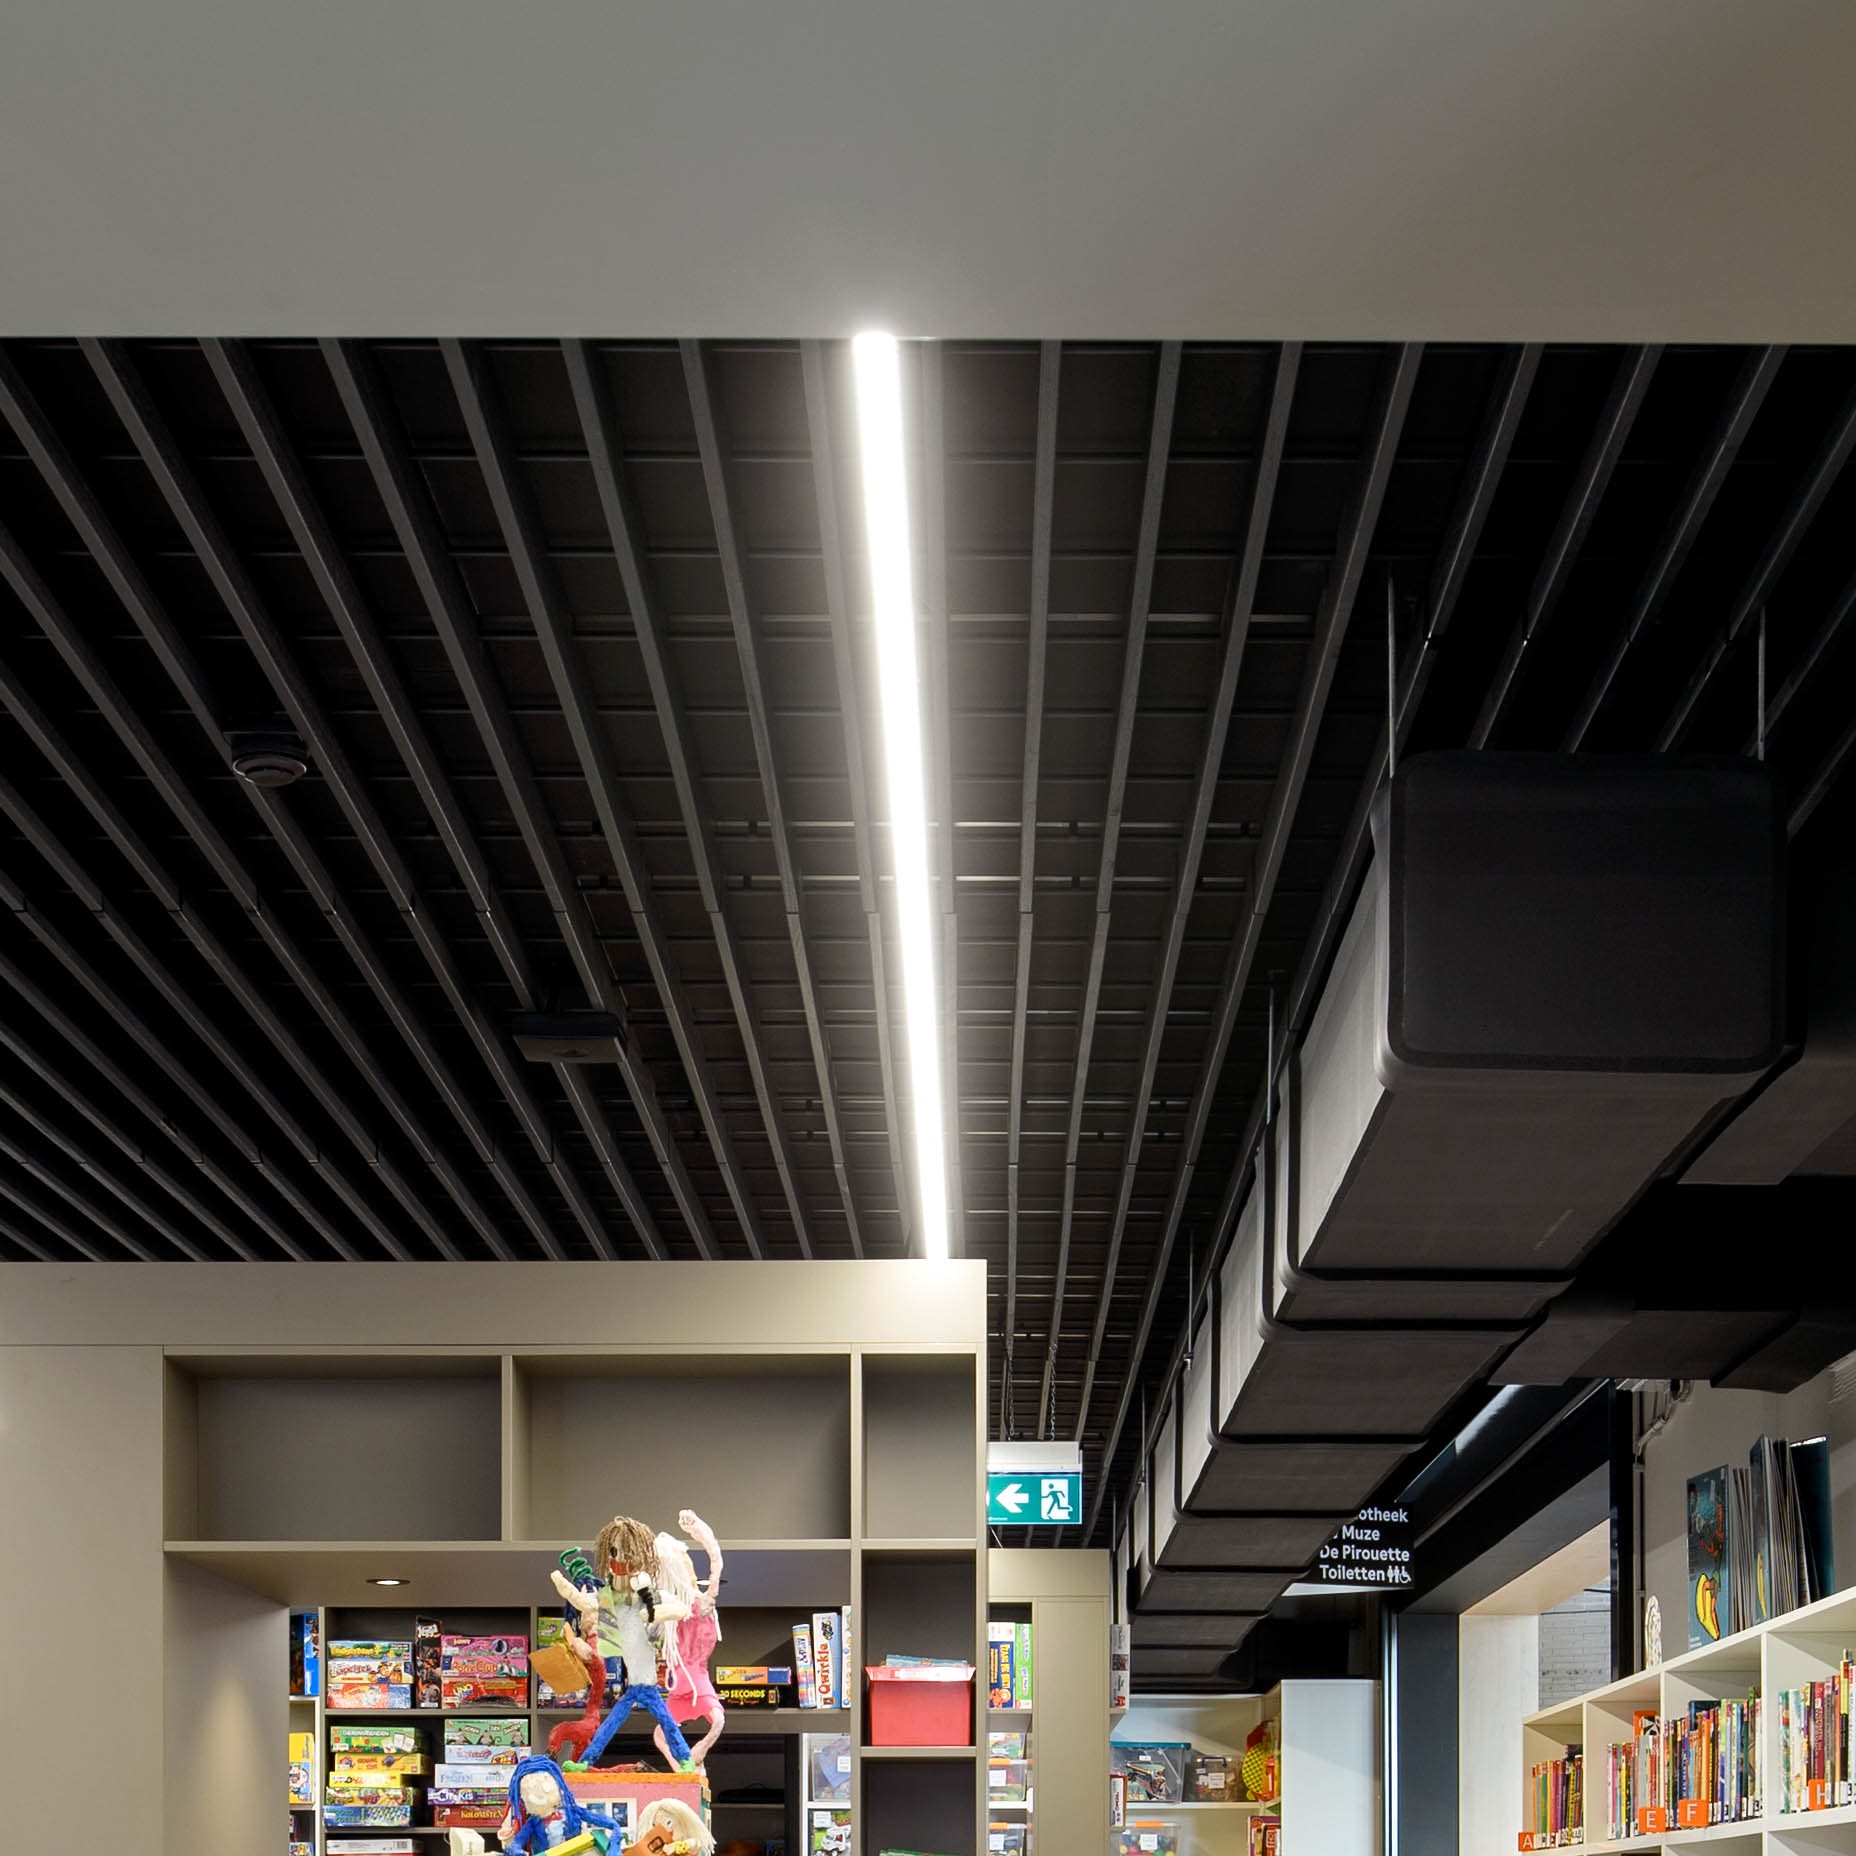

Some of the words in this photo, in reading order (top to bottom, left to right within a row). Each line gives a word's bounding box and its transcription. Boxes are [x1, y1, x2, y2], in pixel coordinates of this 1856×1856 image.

[1358, 1506, 1409, 1523] otheek
[1342, 1525, 1381, 1541] Muze
[1319, 1545, 1339, 1559] De
[1342, 1545, 1410, 1562] Pirouette
[1319, 1564, 1385, 1581] Toiletten
[817, 1642, 831, 1695] Qwirkle
[730, 1689, 765, 1698] SECONDS
[1816, 1785, 1826, 1804] H
[1646, 1812, 1656, 1828] E
[1687, 1804, 1697, 1821] F
[1522, 1834, 1534, 1849] A
